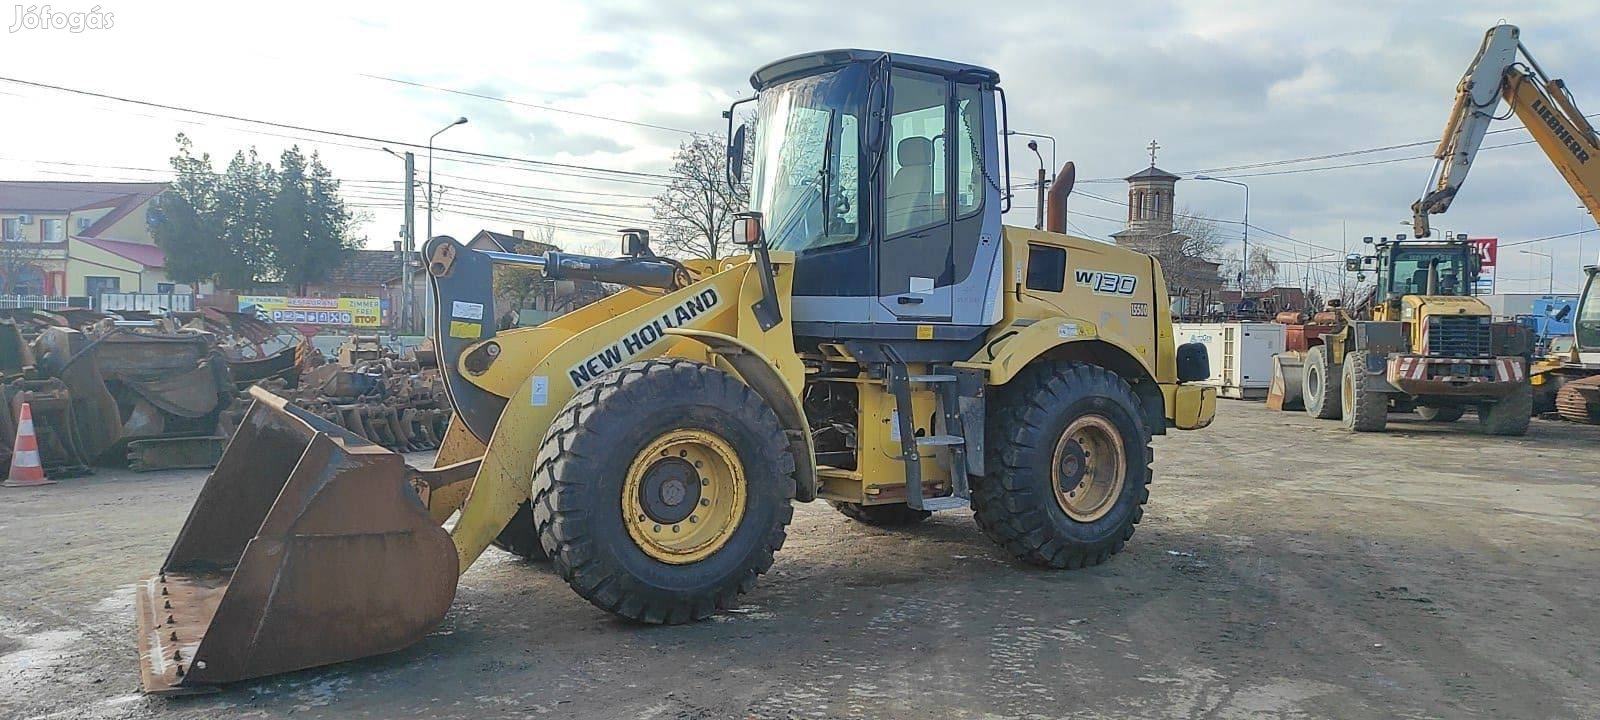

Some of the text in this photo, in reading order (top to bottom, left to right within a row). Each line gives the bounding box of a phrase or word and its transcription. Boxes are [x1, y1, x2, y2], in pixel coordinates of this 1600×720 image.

[1531, 99, 1589, 165] LIEBHERR
[1076, 271, 1136, 294] W130
[569, 288, 718, 388] NEW HOLLAND
